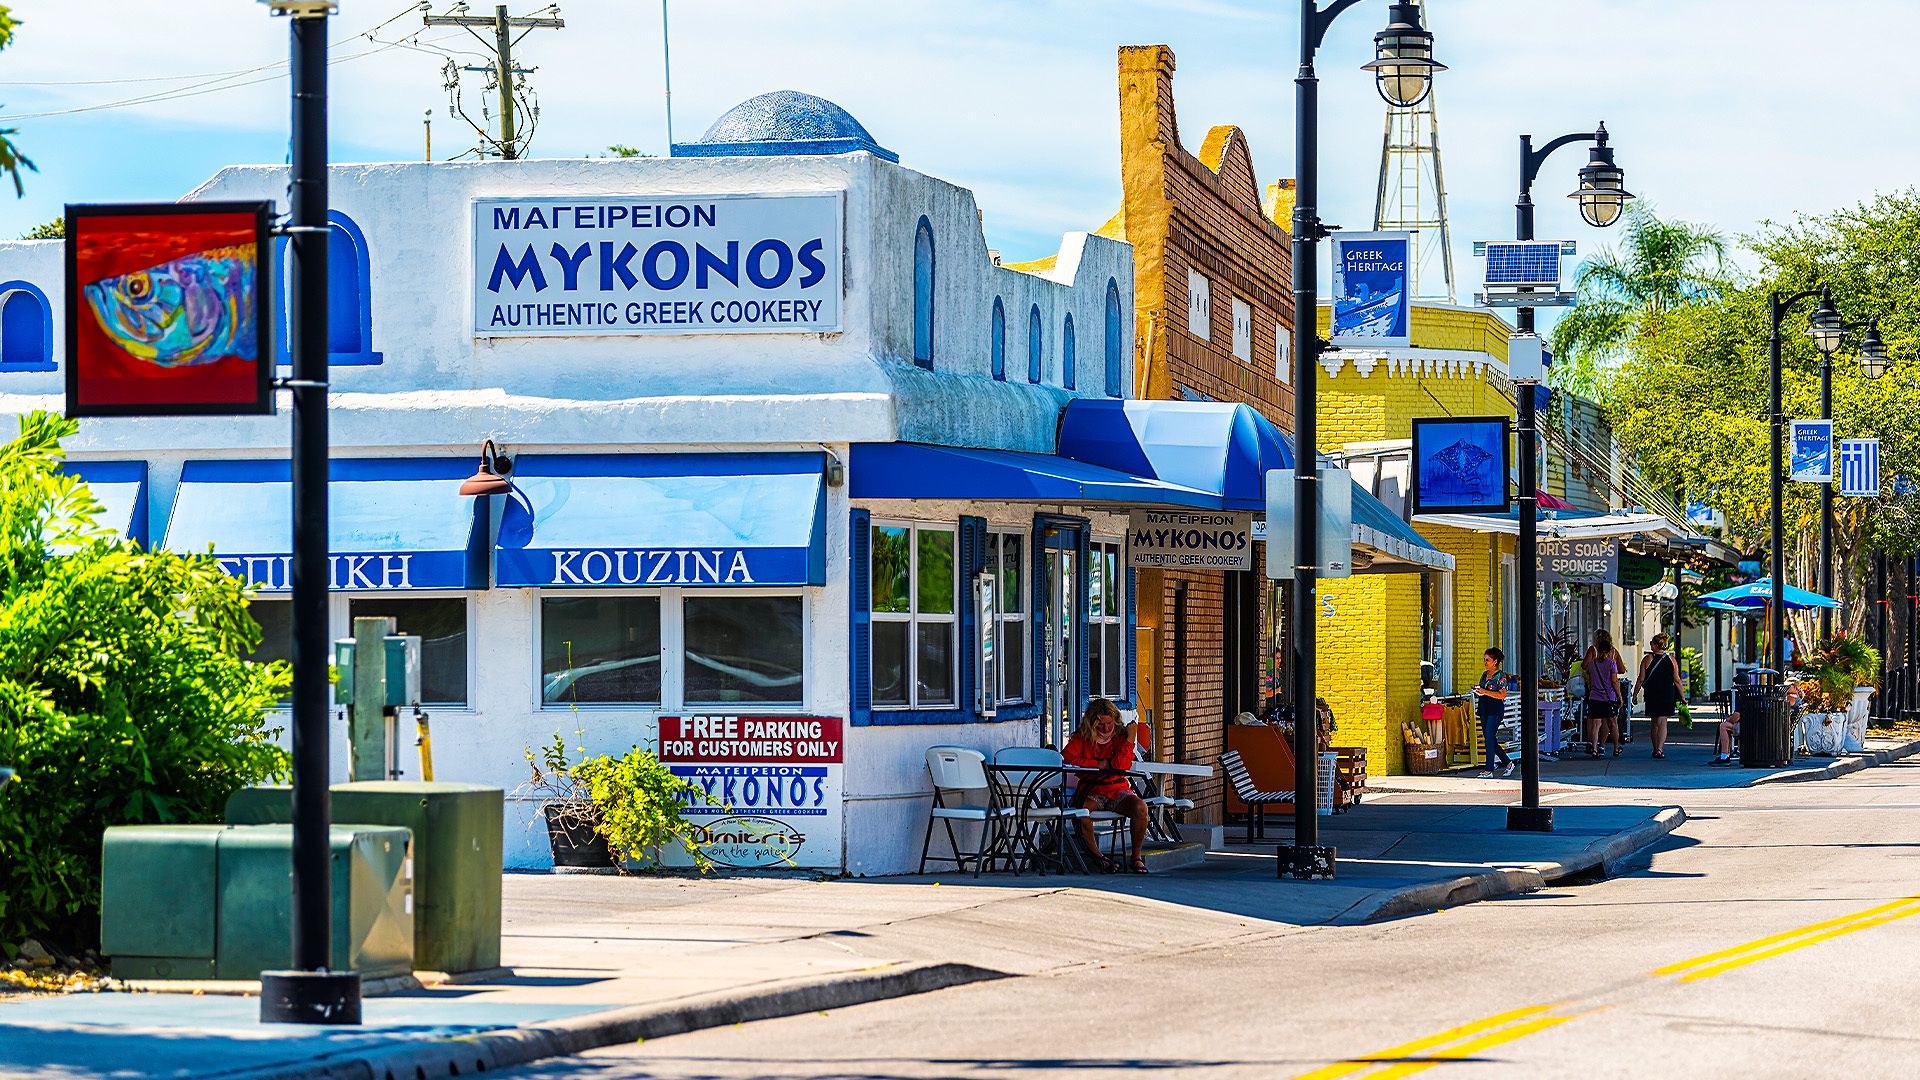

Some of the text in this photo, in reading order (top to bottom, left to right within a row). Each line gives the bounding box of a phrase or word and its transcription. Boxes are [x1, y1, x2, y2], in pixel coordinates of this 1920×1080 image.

[493, 204, 717, 230] ΜΑΓΕΙΡΕΙΟΝ
[1346, 250, 1383, 261] GREEK
[486, 237, 827, 294] MYKONOS
[1347, 261, 1404, 272] HERITAGE
[490, 299, 823, 327] AUTHENTIC GREEK COOKERY
[1146, 514, 1234, 526] ΜΑΓΕΙΡΕΙΟΝ
[1133, 528, 1247, 551] MYKONOS
[1536, 543, 1615, 557] ORI'S SOAPS
[1134, 553, 1244, 566] AUTHENTIC GREEK COOKERY
[1551, 559, 1608, 573] SPONGES
[215, 556, 413, 589] ΣΠΙΙΚΗ
[551, 550, 754, 586] KOUZINA
[679, 716, 822, 739] FREE PARKING
[663, 741, 838, 757] FOR CUSTOMERS ONLY
[695, 767, 803, 775] ΜΑΓΕΙΡΕΙΟΝ
[730, 845, 749, 858] the
